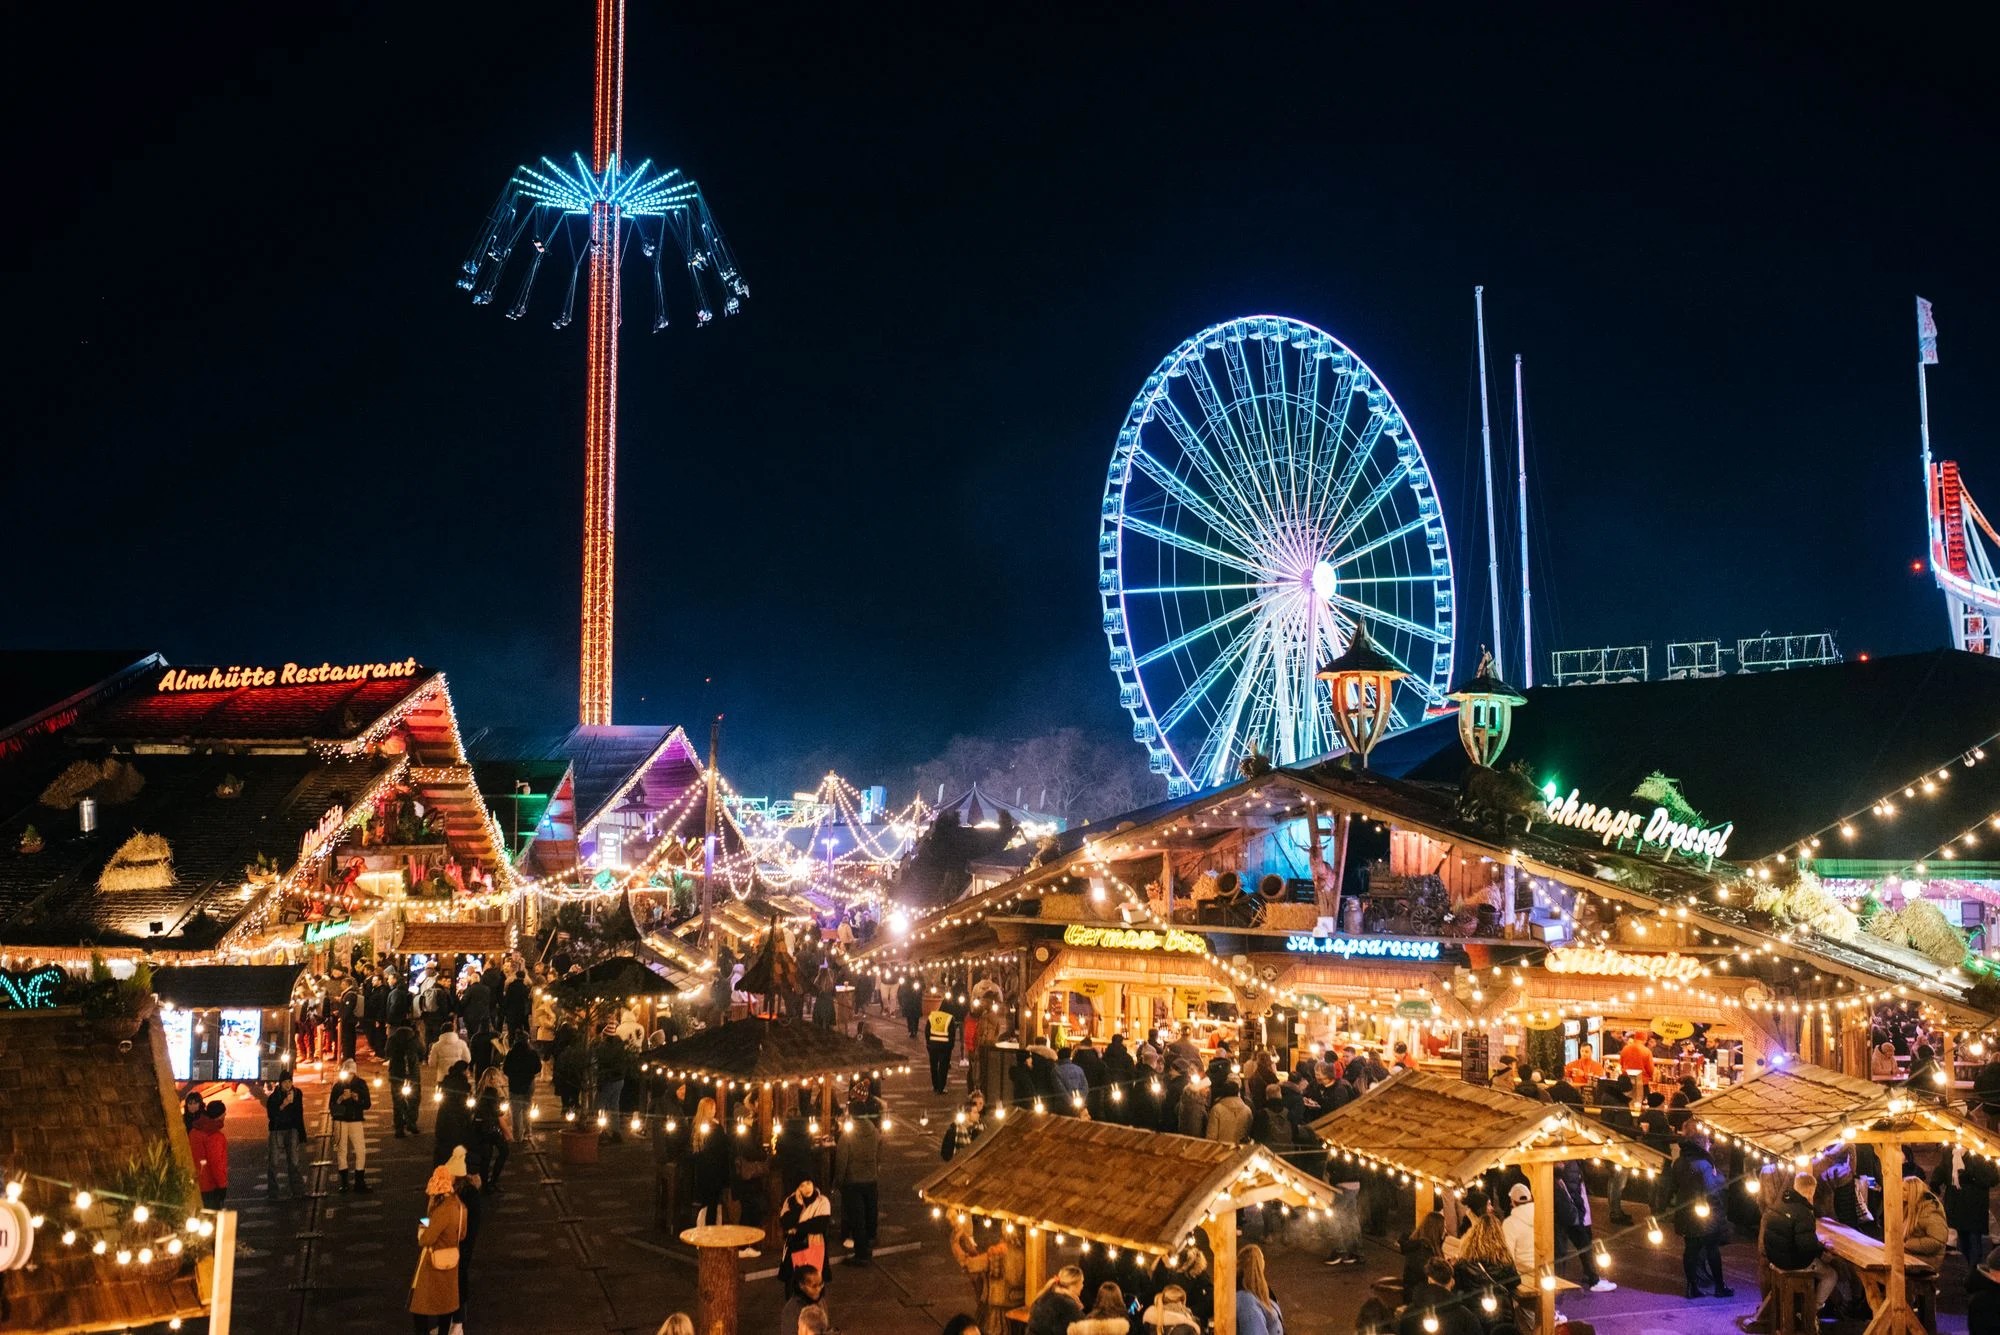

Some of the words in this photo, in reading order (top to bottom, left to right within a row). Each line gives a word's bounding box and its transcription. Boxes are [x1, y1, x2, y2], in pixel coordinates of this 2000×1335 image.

[158, 666, 276, 691] Almhütte
[280, 656, 416, 685] Restaurant
[1643, 807, 1734, 858] Drossel
[1064, 924, 1157, 949] German
[1661, 1021, 1683, 1029] Collect
